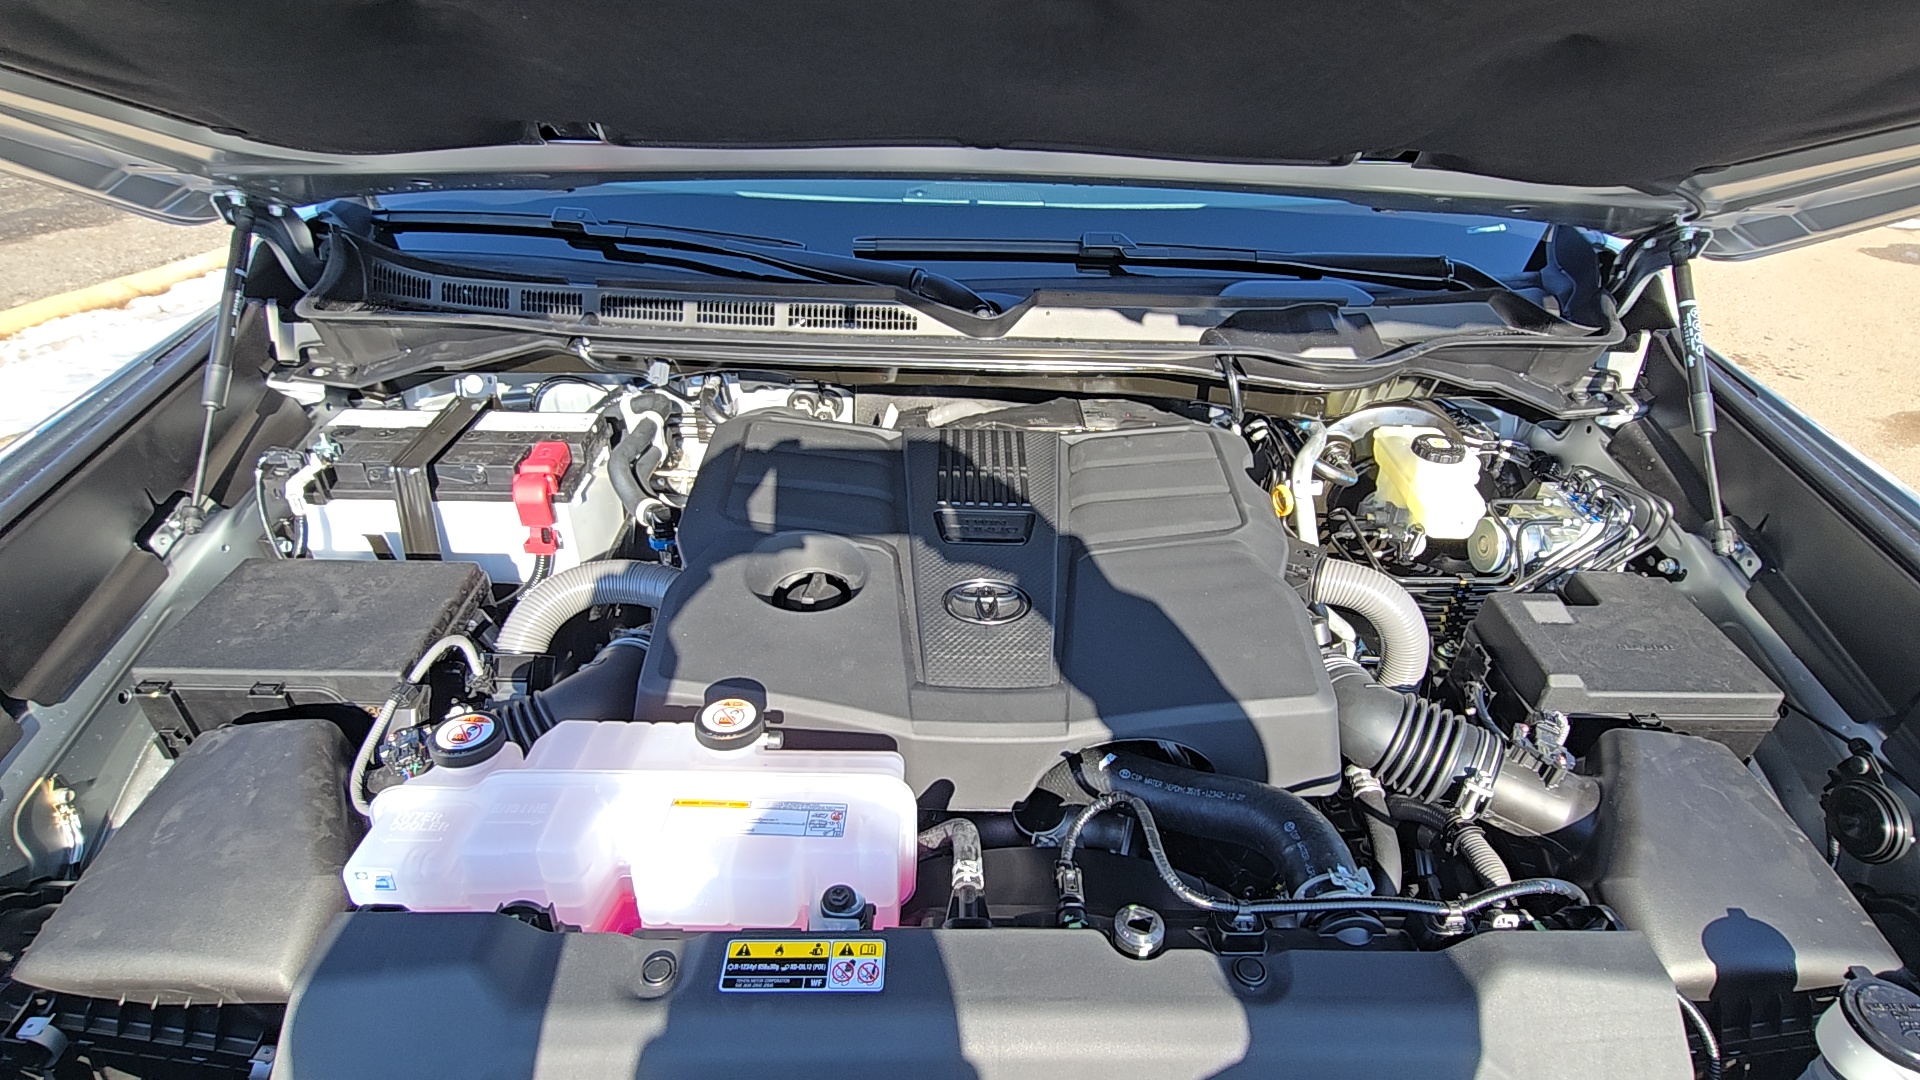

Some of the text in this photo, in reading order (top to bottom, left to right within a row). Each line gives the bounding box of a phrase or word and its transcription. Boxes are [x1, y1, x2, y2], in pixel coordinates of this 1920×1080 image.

[1144, 777, 1163, 788] WATER
[491, 803, 549, 814] ENGINE
[393, 811, 443, 823] INTER
[389, 821, 450, 832] COOLER
